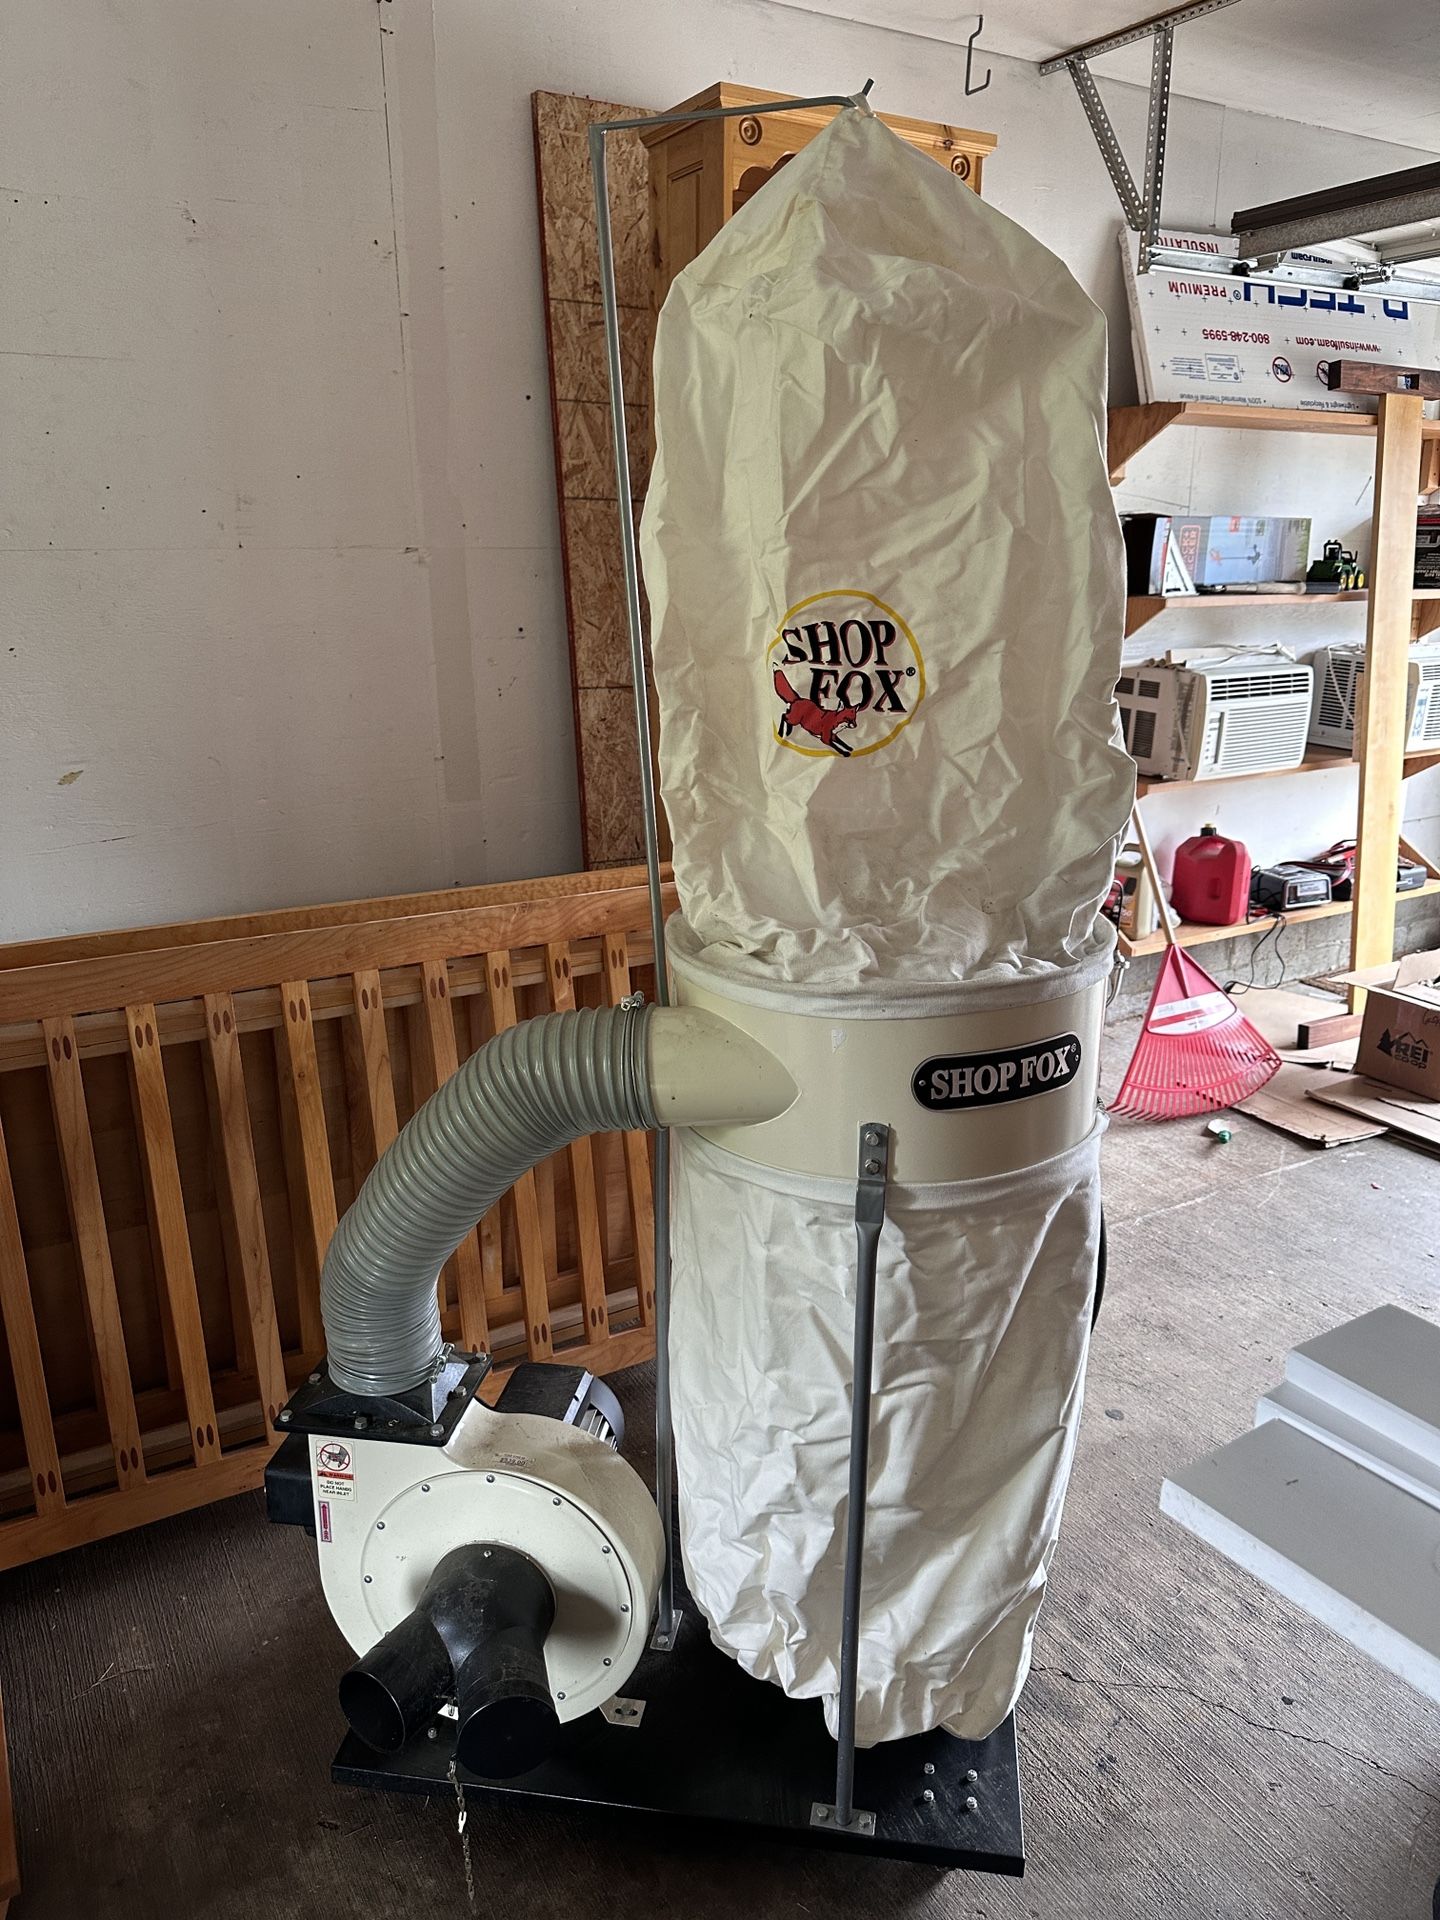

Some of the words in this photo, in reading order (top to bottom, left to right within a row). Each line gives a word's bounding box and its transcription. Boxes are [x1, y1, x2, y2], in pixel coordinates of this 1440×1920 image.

[1156, 236, 1219, 254] INSULATIO
[1168, 281, 1227, 298] PREMIUM
[1202, 328, 1270, 344] 800-248-5995
[1296, 337, 1379, 353] www.insulfoam.com
[781, 619, 896, 669] SHOP
[1395, 1042, 1429, 1064] REI
[931, 1061, 1016, 1100] SHOP
